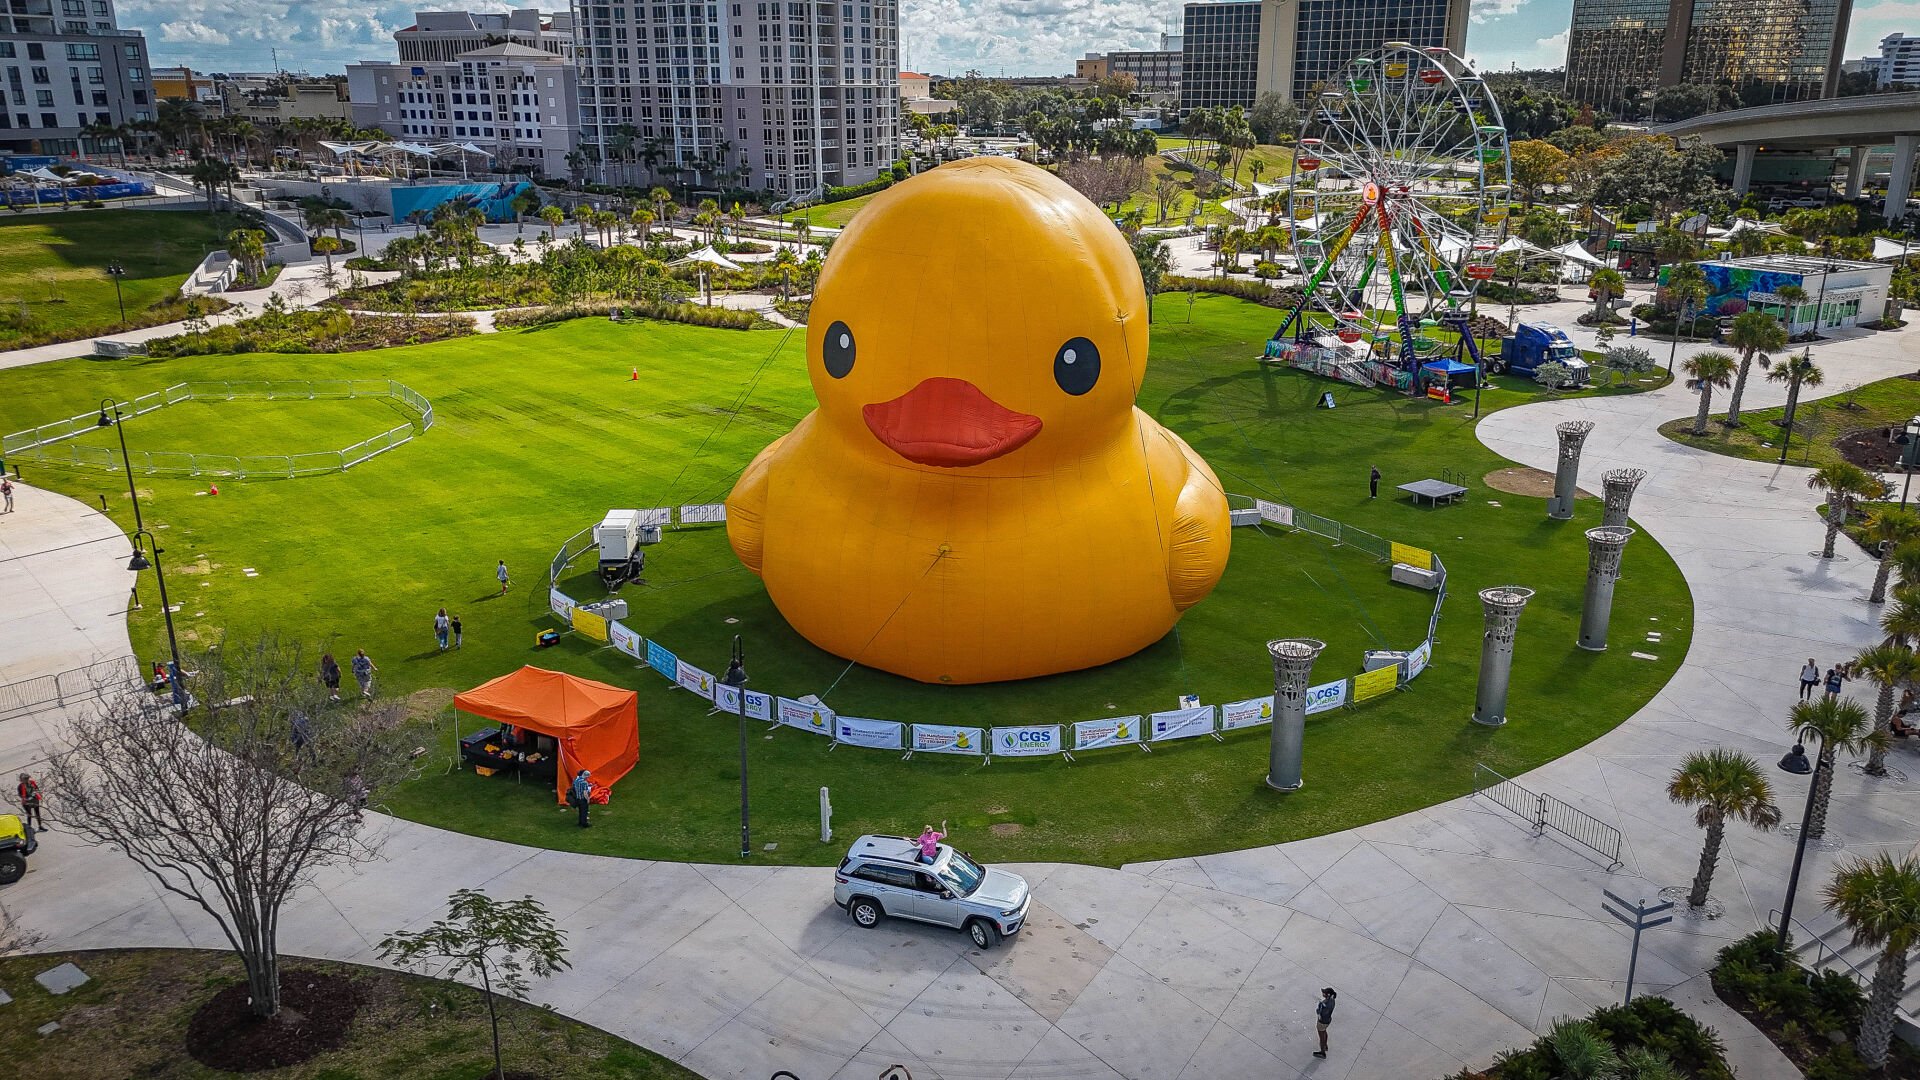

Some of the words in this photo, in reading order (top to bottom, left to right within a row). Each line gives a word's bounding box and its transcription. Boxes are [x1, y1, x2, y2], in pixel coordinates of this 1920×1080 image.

[738, 692, 762, 706] GS
[1317, 685, 1340, 700] CGS
[1019, 731, 1051, 742] CGS
